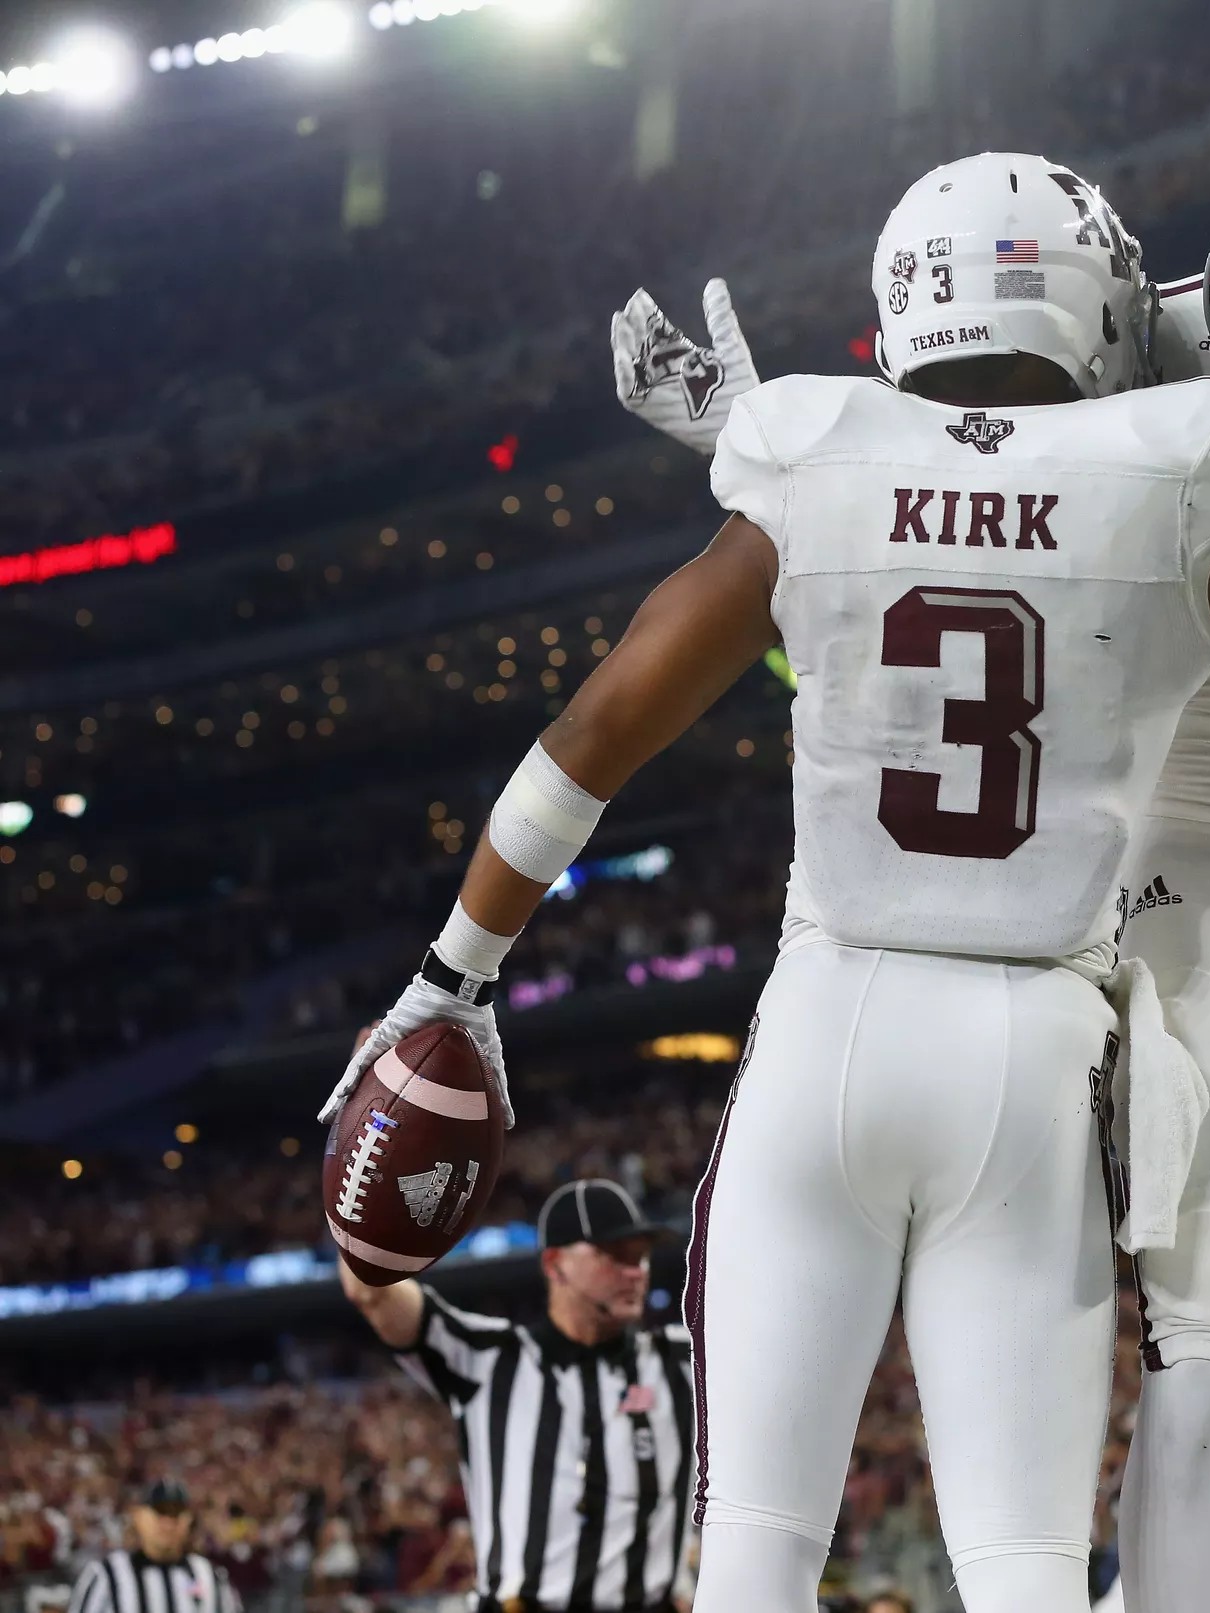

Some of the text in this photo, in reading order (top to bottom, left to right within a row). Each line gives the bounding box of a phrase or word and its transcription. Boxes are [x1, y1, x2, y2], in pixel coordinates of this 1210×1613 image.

[889, 282, 908, 314] SEC
[932, 264, 954, 304] 3
[910, 324, 990, 352] TEXAS A&M
[889, 488, 1059, 550] KIRK
[877, 585, 1045, 859] 3
[1129, 894, 1183, 919] adidas
